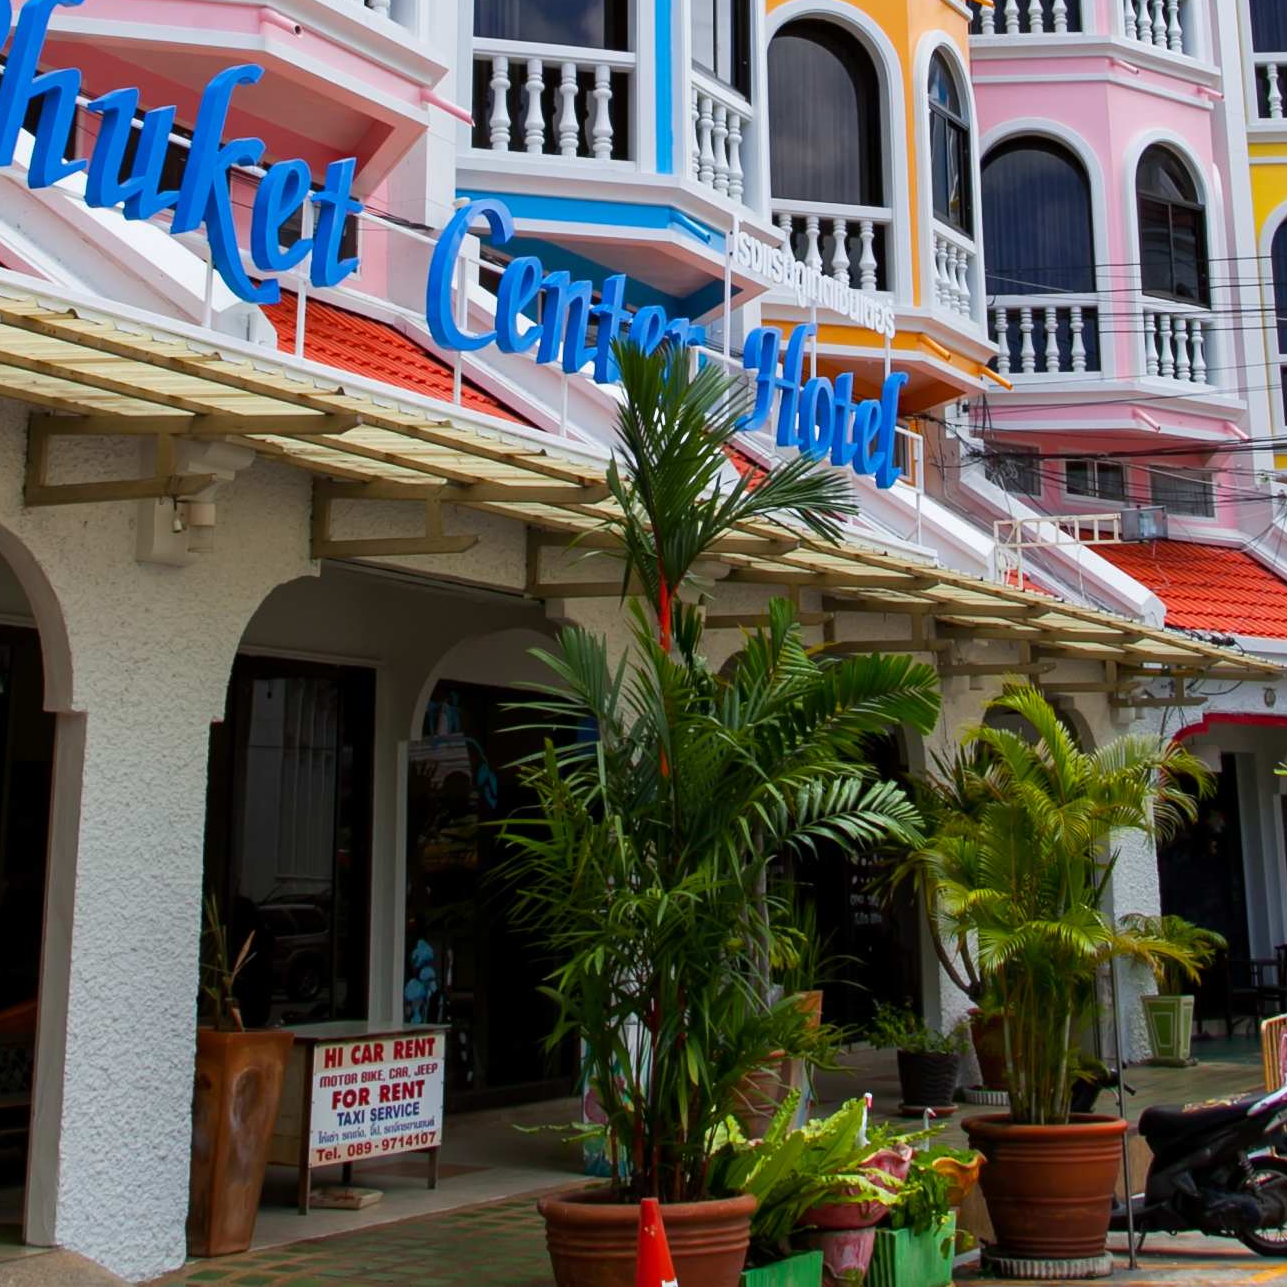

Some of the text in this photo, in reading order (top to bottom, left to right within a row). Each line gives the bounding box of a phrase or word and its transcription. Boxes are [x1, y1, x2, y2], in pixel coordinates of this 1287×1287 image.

[734, 322, 909, 490] Hotel
[324, 1037, 435, 1069] HI CAR RENT
[319, 1063, 438, 1088] MOTOR BIKE, CAR, JEEP
[331, 1079, 425, 1110] FOR RENT
[337, 1102, 420, 1126] TAXI SERVICE
[316, 1147, 341, 1161] Tel.
